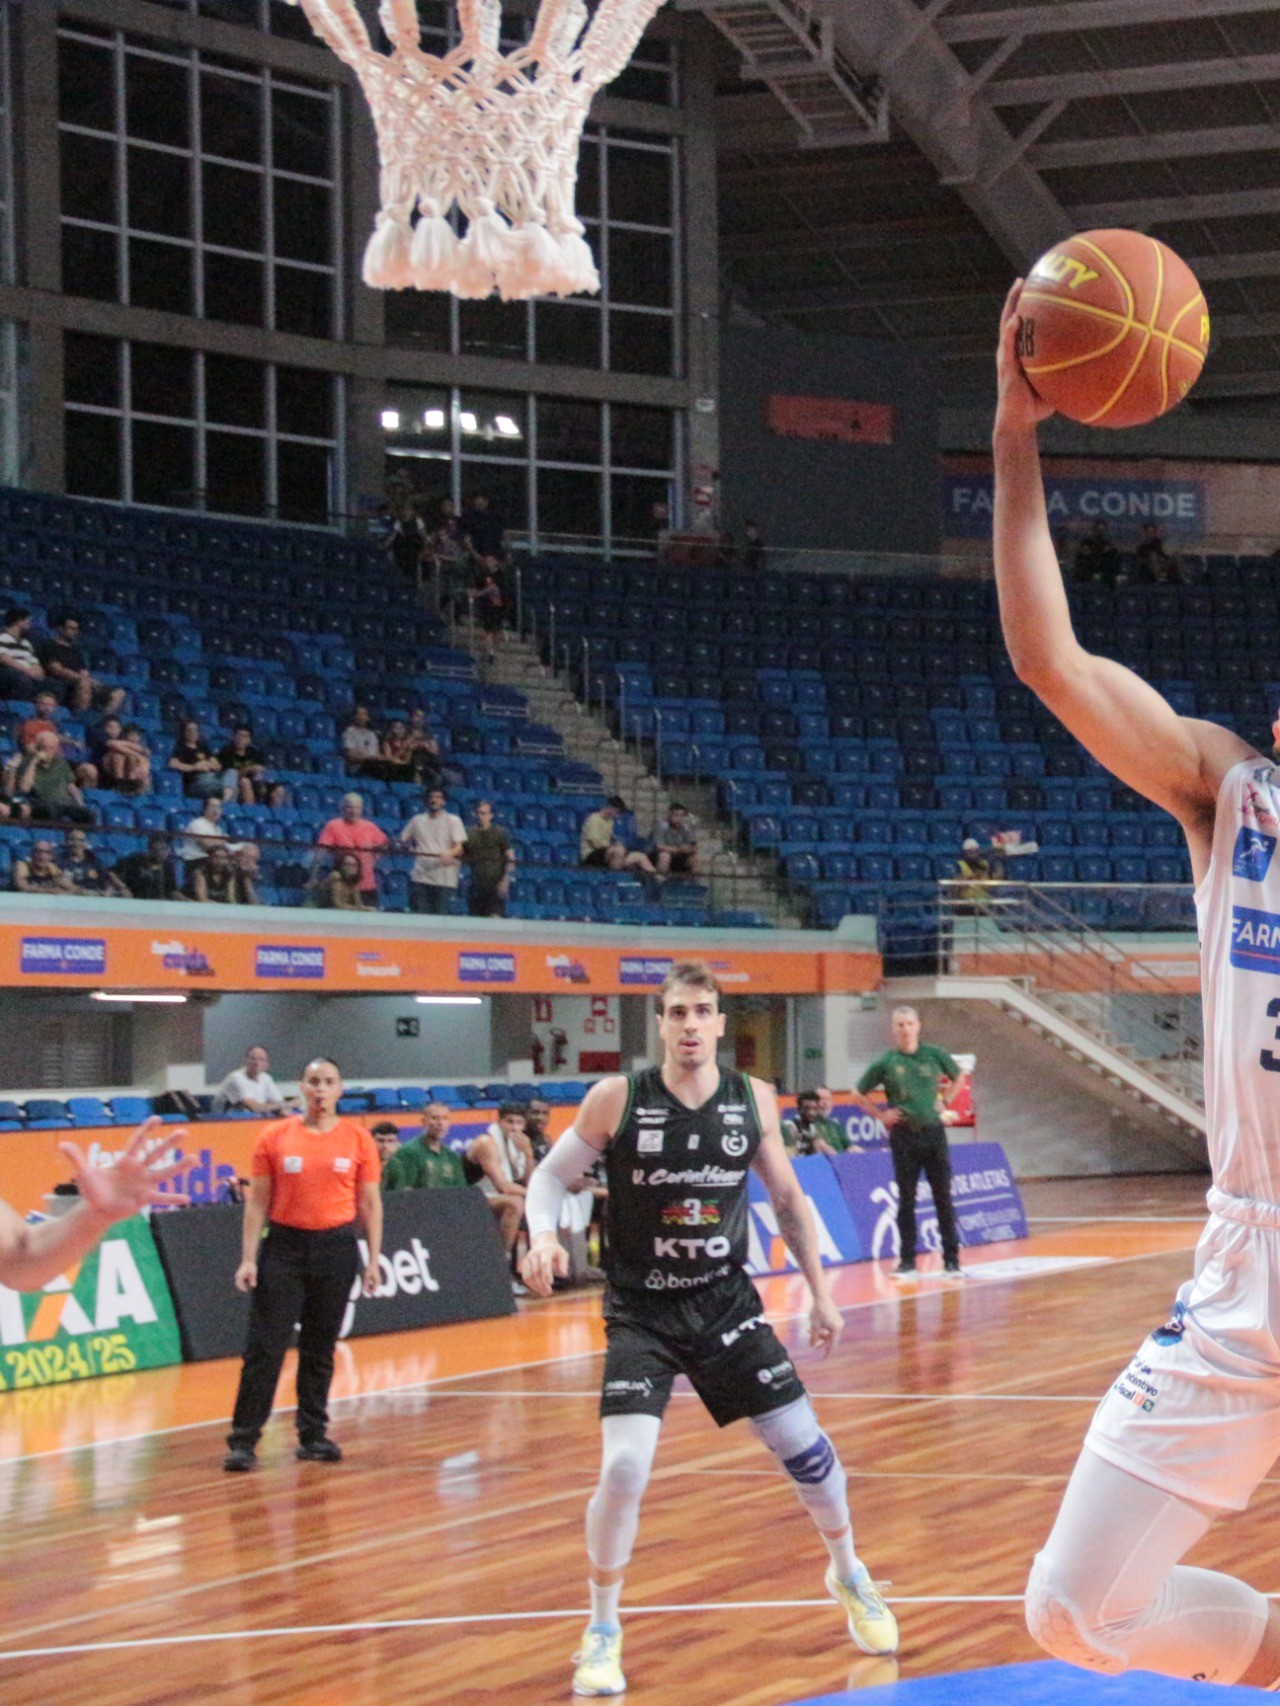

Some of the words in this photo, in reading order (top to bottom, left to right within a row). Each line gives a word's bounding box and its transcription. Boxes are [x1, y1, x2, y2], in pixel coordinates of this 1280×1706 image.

[1078, 490, 1197, 519] CONDE
[22, 943, 63, 959] FARMA
[64, 944, 105, 961] CONDE
[682, 1198, 703, 1226] 3
[654, 1235, 731, 1259] KTO
[5, 1333, 137, 1388] 2024/25
